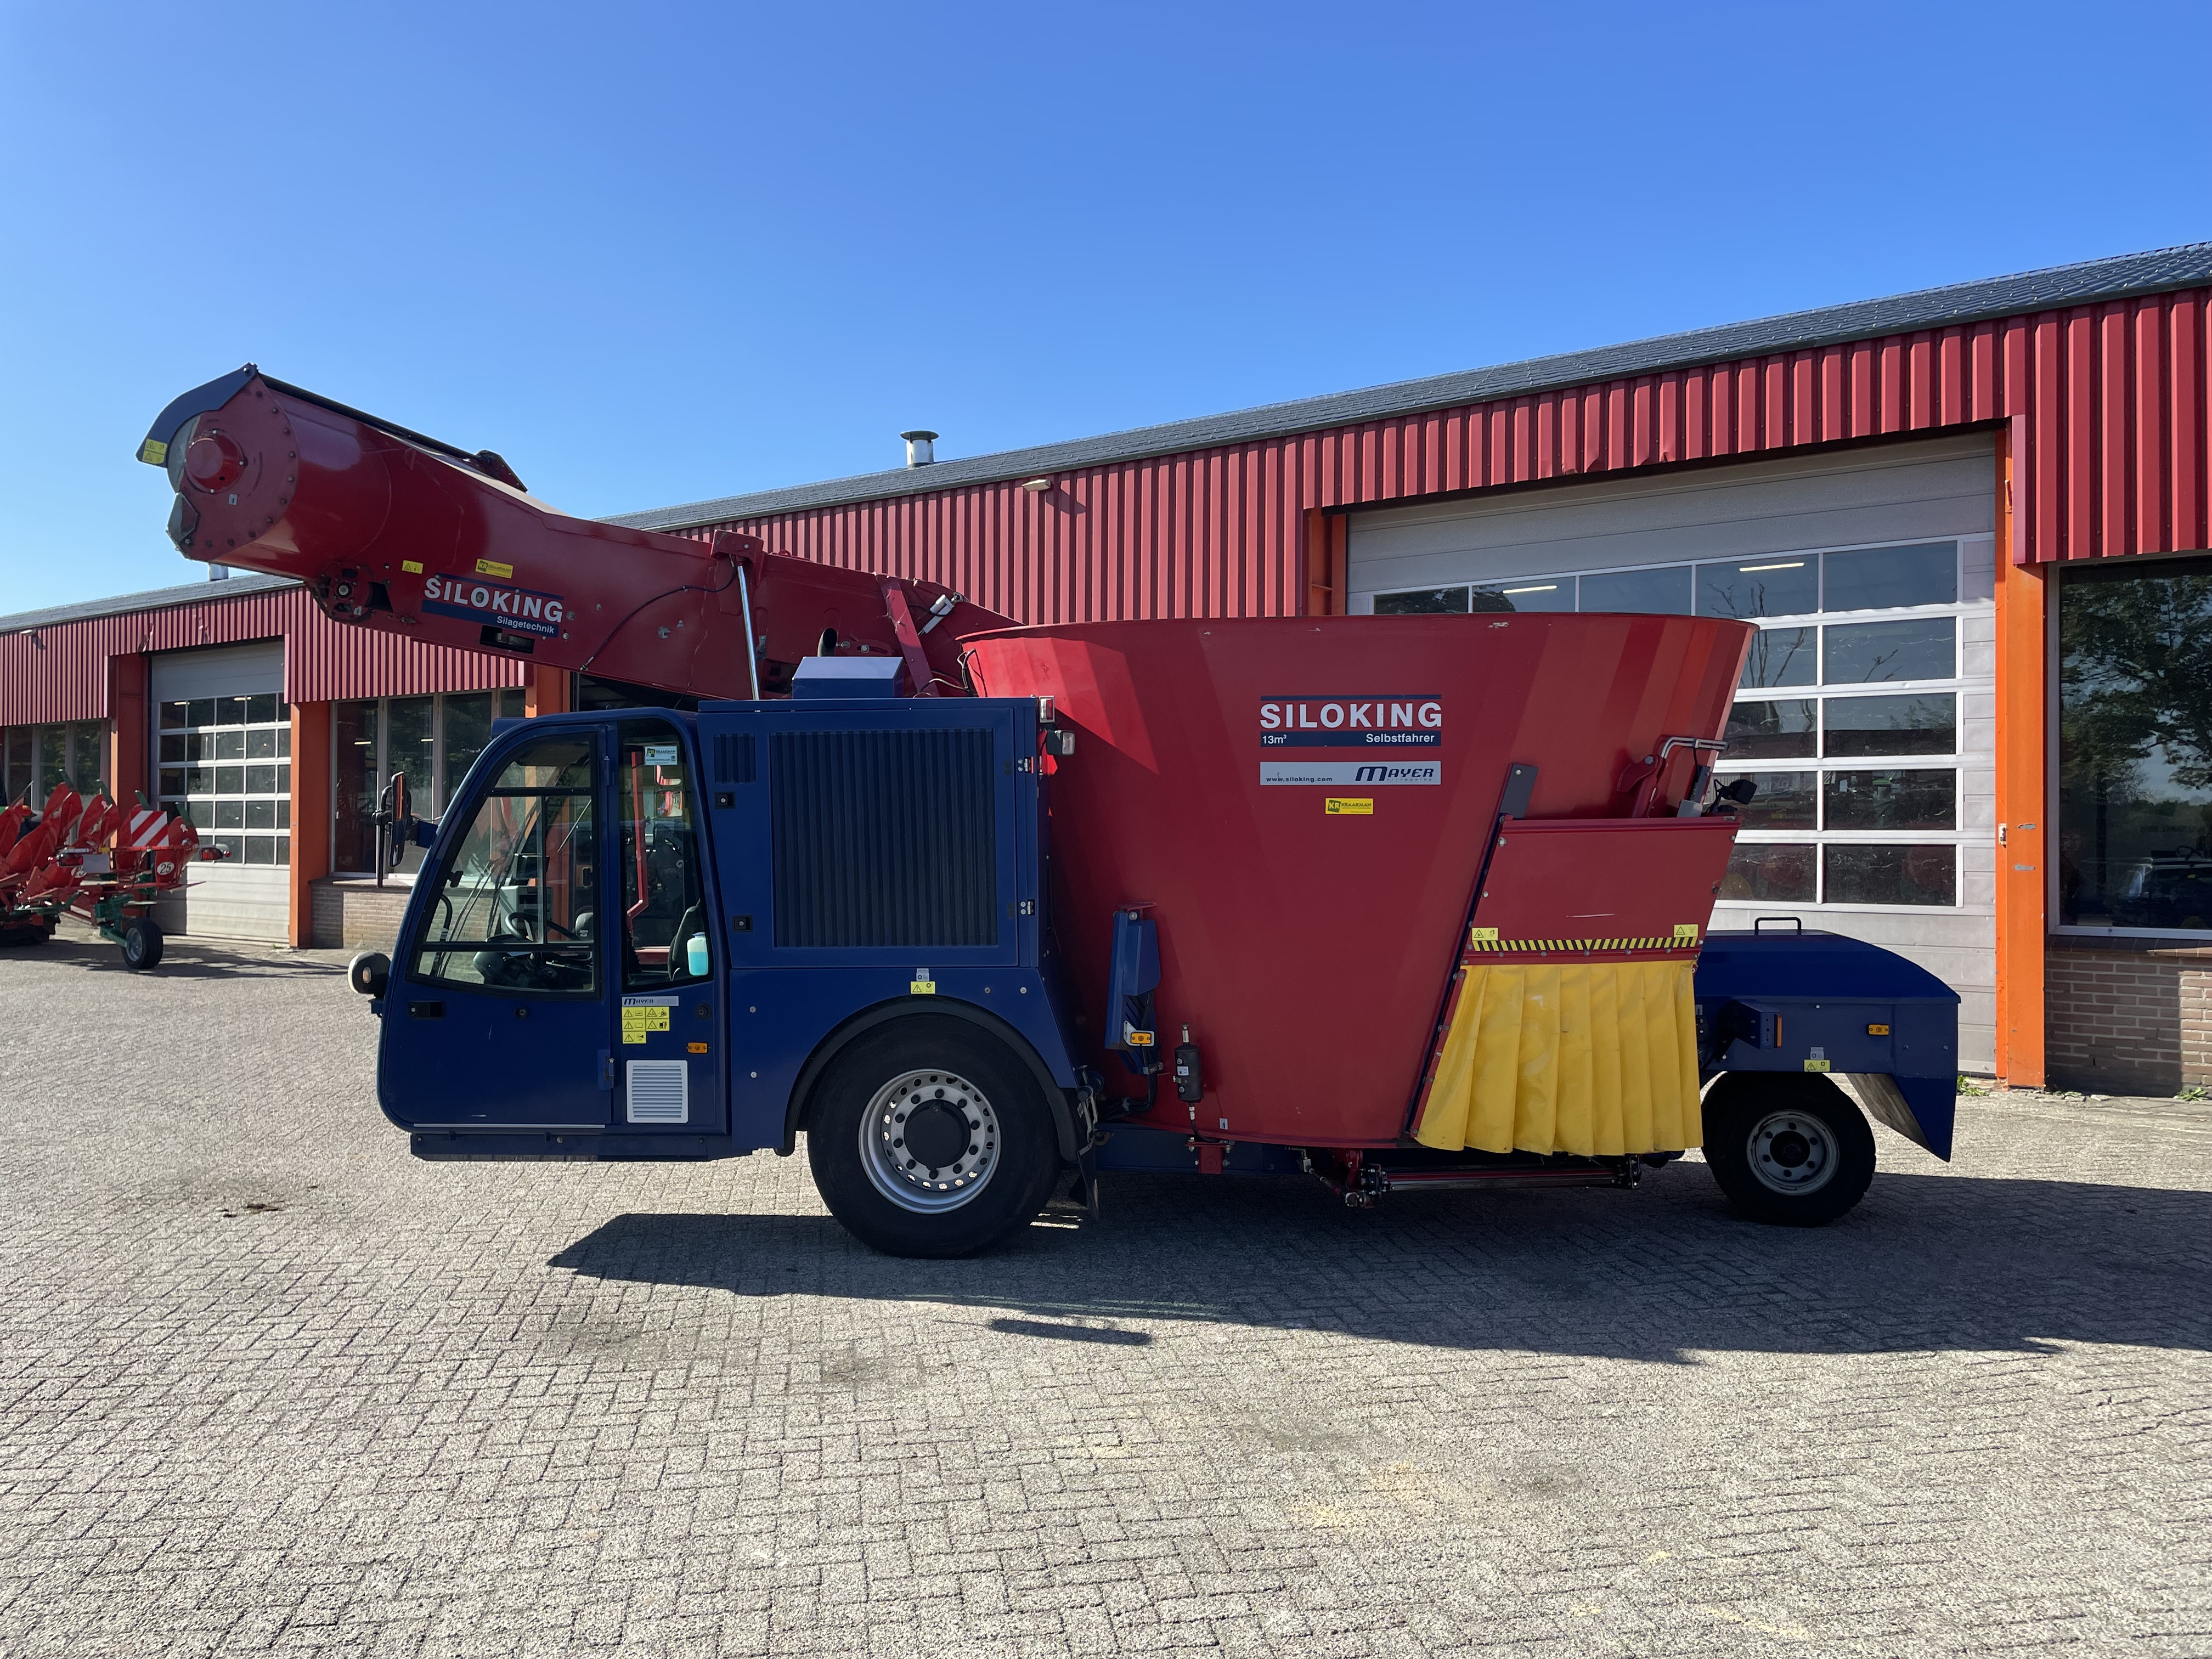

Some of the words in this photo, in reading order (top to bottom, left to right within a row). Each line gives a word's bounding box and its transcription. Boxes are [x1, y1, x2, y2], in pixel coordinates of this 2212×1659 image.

[424, 578, 563, 623] SILOKING
[496, 616, 555, 634] Silagetechnik
[1260, 702, 1442, 729] SILOKING
[1262, 734, 1287, 744] 13m³
[1366, 733, 1435, 743] Selbstfahrer
[1355, 766, 1434, 782] MAYER
[160, 864, 172, 874] 25
